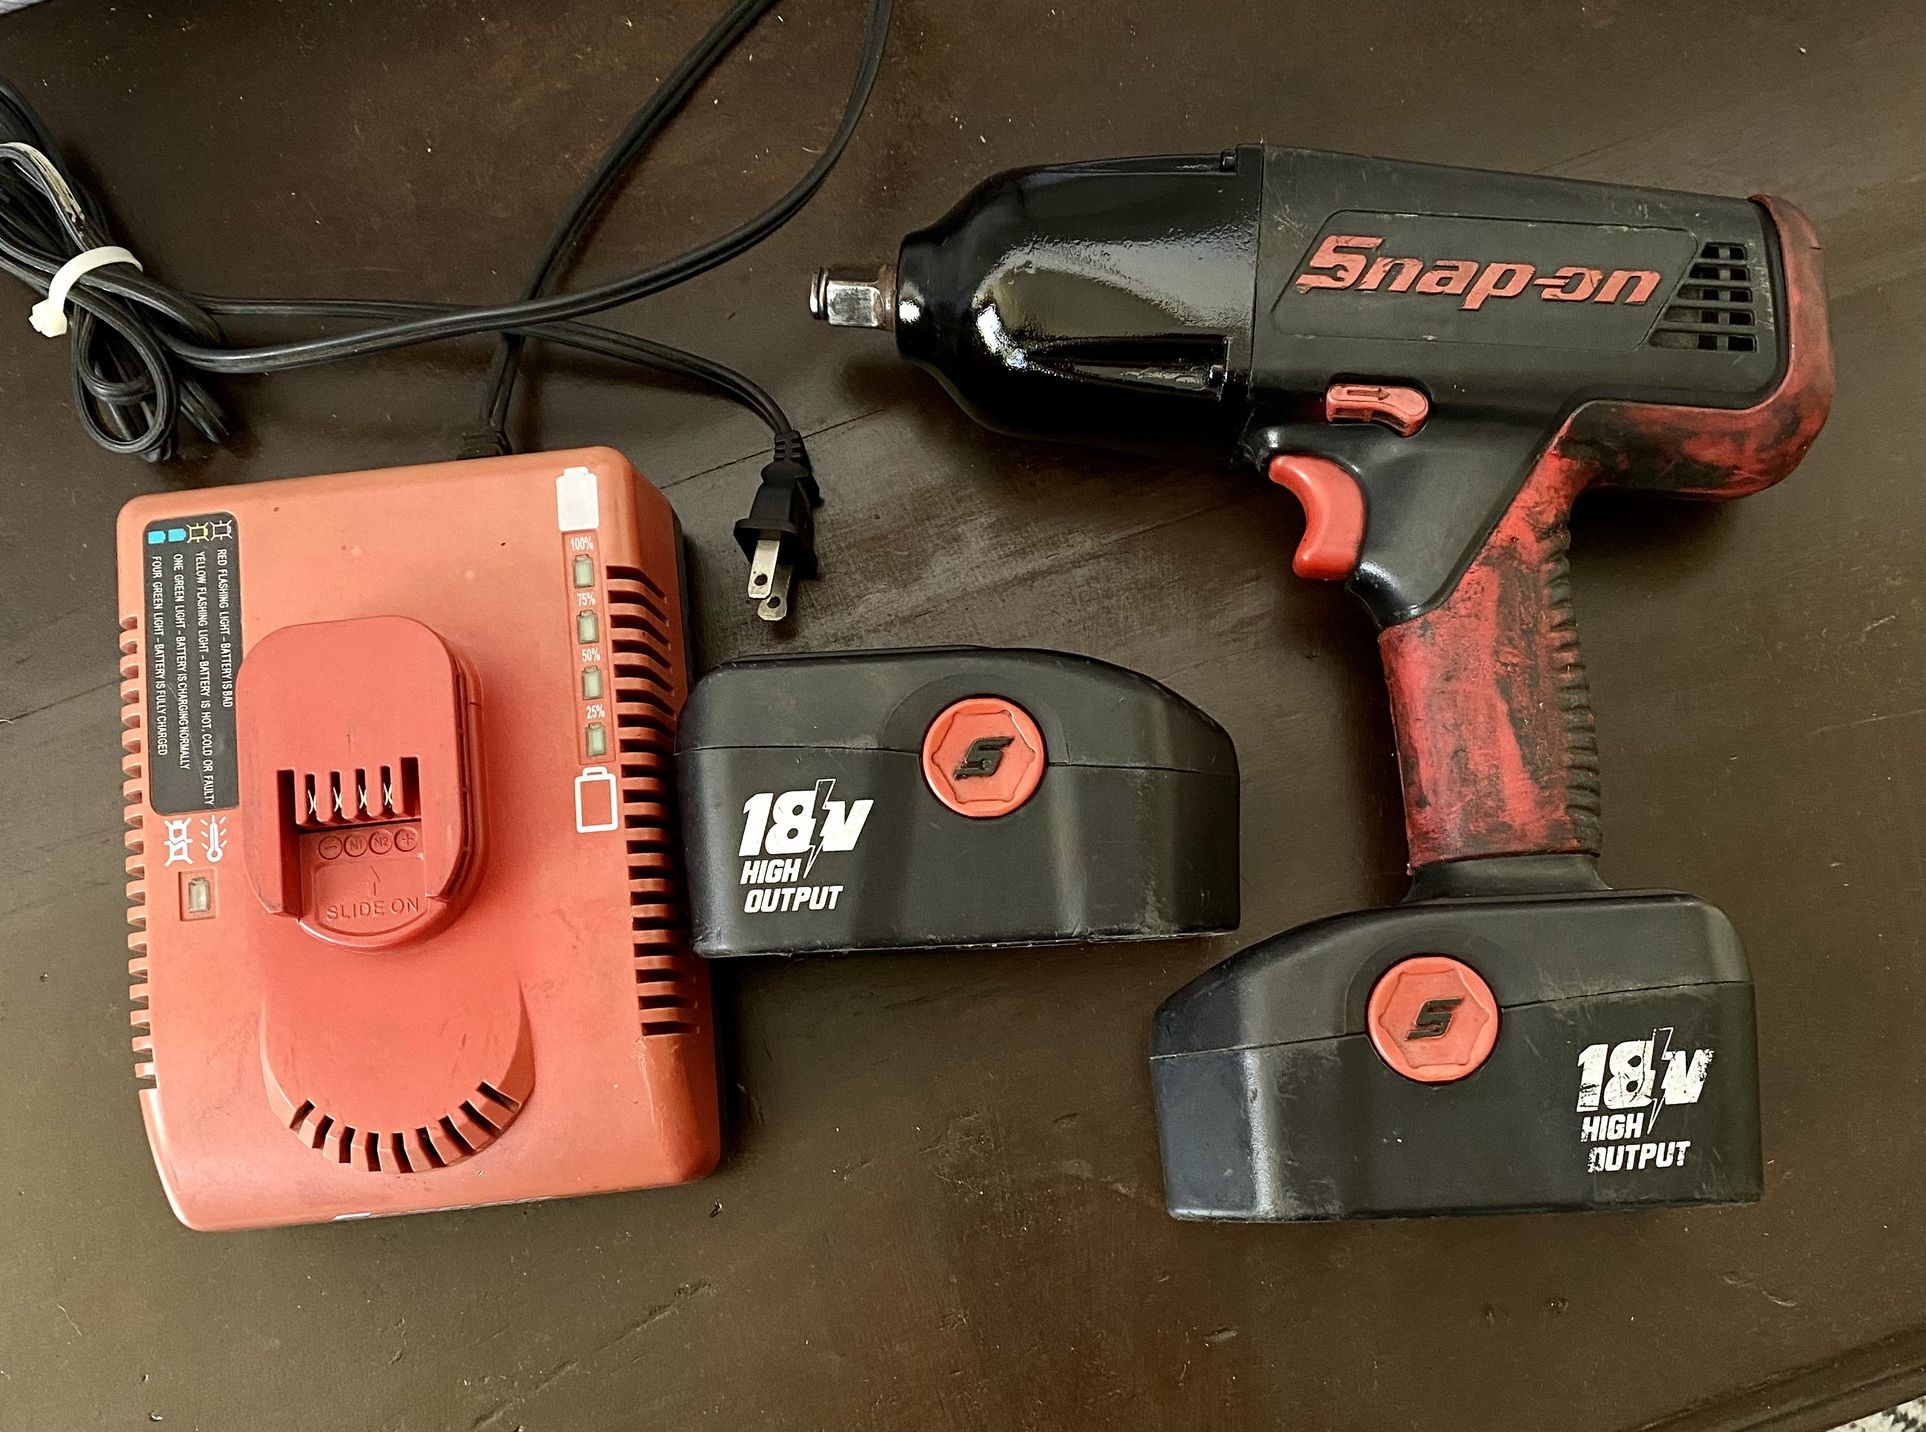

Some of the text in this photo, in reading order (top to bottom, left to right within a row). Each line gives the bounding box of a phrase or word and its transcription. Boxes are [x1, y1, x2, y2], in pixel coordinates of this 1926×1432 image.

[1296, 234, 1661, 310] Snap-on
[570, 536, 594, 551] 100%
[152, 556, 162, 579] FOUR
[173, 553, 184, 571] ONE
[196, 551, 207, 584] YELLOW
[217, 548, 228, 566] RED
[152, 581, 164, 610] GREEN
[174, 574, 185, 602] GREEN
[218, 569, 229, 609] FLASHING
[577, 592, 596, 606] 75%
[175, 605, 186, 629] LIGHT
[197, 587, 208, 627] FLASHING
[153, 612, 164, 636] LIGHT
[219, 611, 230, 635] LIGHT
[198, 630, 209, 653] LIGHT
[154, 643, 166, 679] BATTERY
[175, 636, 187, 672] BATTERY
[220, 642, 232, 681] BATTERY
[581, 647, 601, 662] 50%
[155, 680, 166, 689] IS
[177, 673, 188, 682] IS
[199, 661, 211, 697] BATTERY
[222, 681, 233, 690] IS
[156, 690, 167, 714] FULLY
[177, 682, 189, 726] CHARGING
[200, 700, 211, 709] IS
[223, 691, 233, 708] BAD
[586, 703, 606, 719] 25%
[201, 711, 212, 732] HOT,
[156, 715, 168, 756] CHARGED
[202, 734, 213, 756] COLD
[178, 726, 190, 770] NORMALLY
[203, 760, 213, 772] OR
[203, 775, 215, 805] FAULTY
[740, 858, 802, 885] HIGH
[326, 897, 419, 920] SLIDE ON
[744, 885, 844, 913] OUTPUT
[1580, 1112, 1645, 1142] HIGH
[1587, 1141, 1691, 1173] OUTPUT
